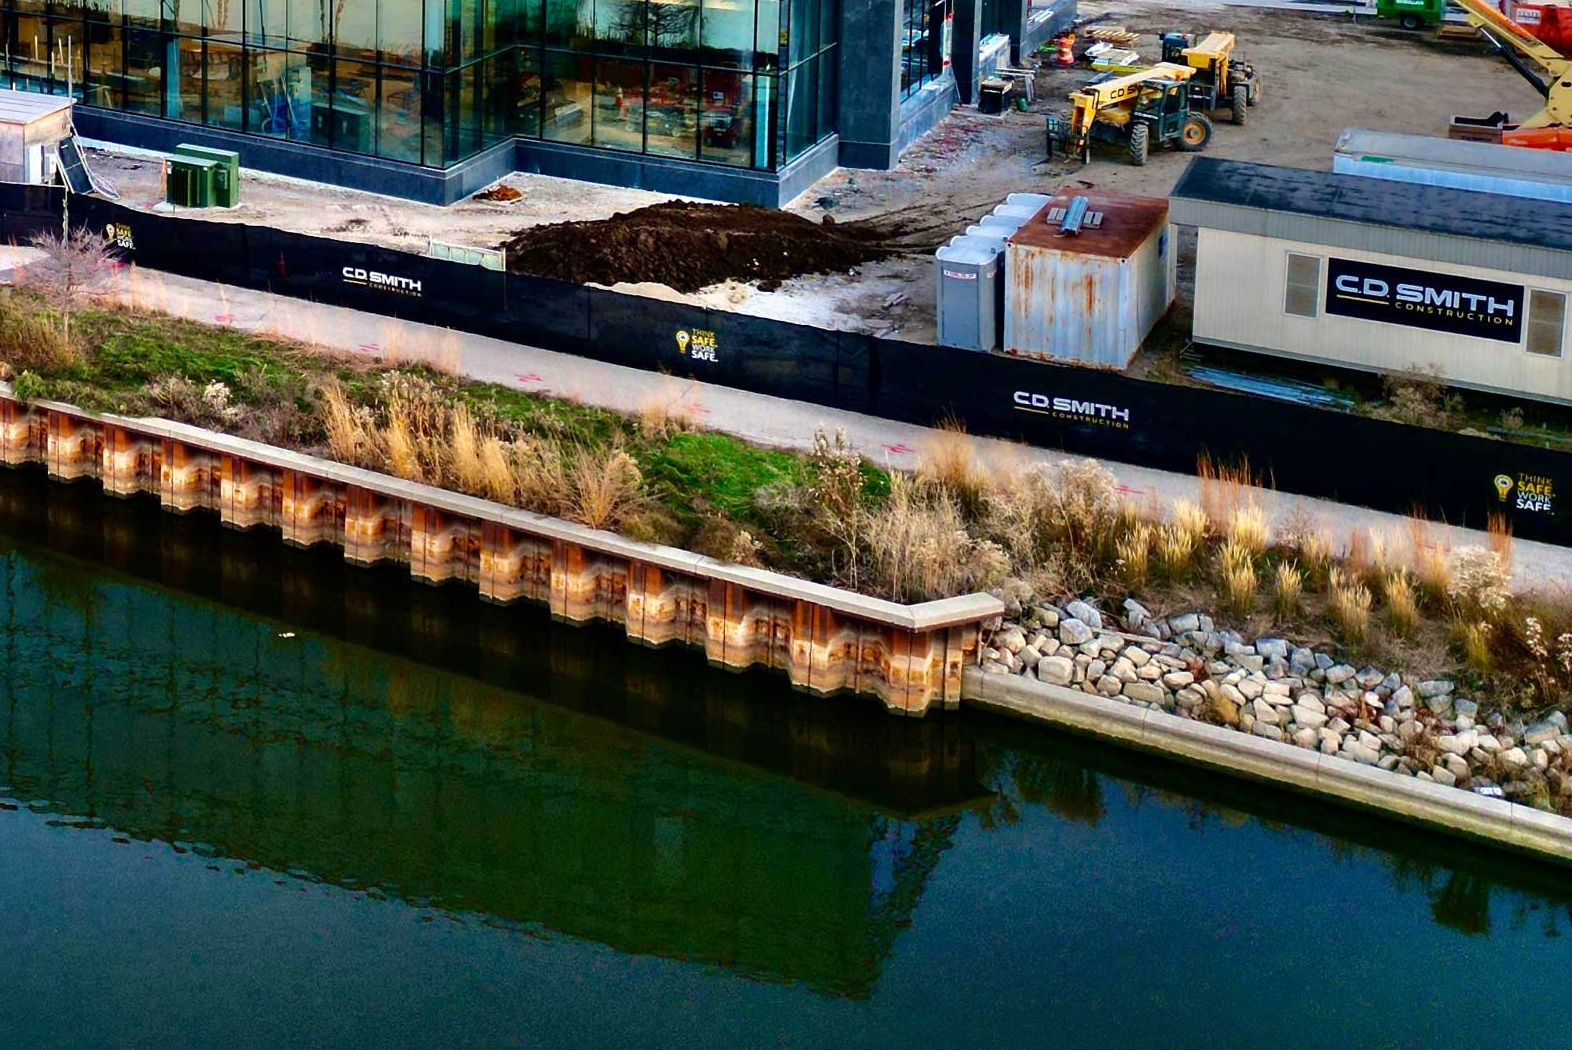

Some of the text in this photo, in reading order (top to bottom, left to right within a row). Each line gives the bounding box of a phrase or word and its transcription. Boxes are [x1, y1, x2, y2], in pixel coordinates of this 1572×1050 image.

[369, 272, 422, 292] SMITH
[1335, 274, 1514, 317] C.D. SMITH
[1394, 301, 1513, 326] CONSTRUCTION
[1053, 397, 1130, 422] SMITH
[1051, 411, 1130, 430] CONSTRUCTION
[1518, 472, 1553, 485] THINK
[1517, 490, 1552, 505] WORK
